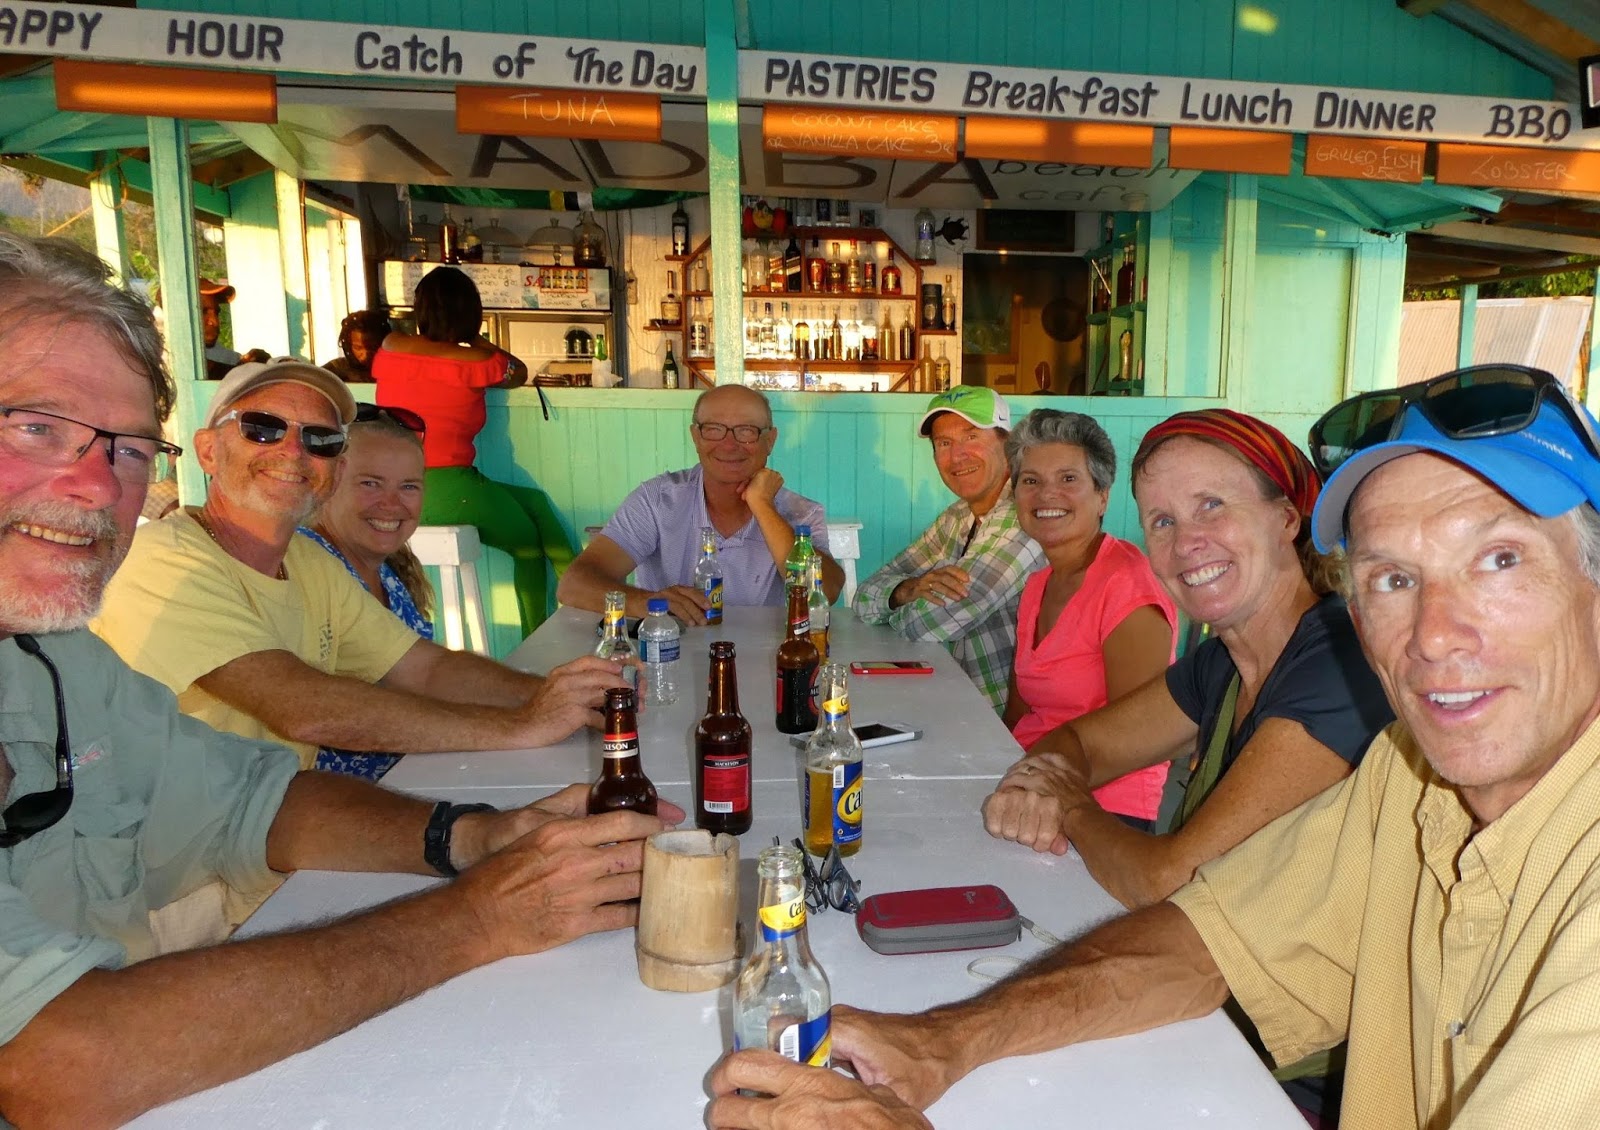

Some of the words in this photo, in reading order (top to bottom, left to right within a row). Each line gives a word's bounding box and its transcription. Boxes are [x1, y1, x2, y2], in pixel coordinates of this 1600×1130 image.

[0, 6, 103, 51] APPY
[166, 18, 285, 63] HOUR
[355, 30, 464, 75] Catch
[492, 41, 538, 80] of
[566, 45, 625, 86] The
[629, 49, 697, 93] Day
[510, 93, 616, 127] TUNA
[764, 57, 939, 103] PASTRIES
[961, 70, 1161, 119] Breakfast
[1313, 91, 1438, 133] DINNER
[1484, 104, 1573, 144] BBQ
[790, 112, 878, 130] COCONUT
[884, 118, 940, 134] CAKE
[279, 120, 999, 199] MADBA
[789, 134, 860, 151] VANILLA
[866, 137, 916, 153] CAKE
[1315, 146, 1378, 166] GRILLED
[1380, 145, 1422, 174] FISH
[1018, 184, 1149, 203] cafe
